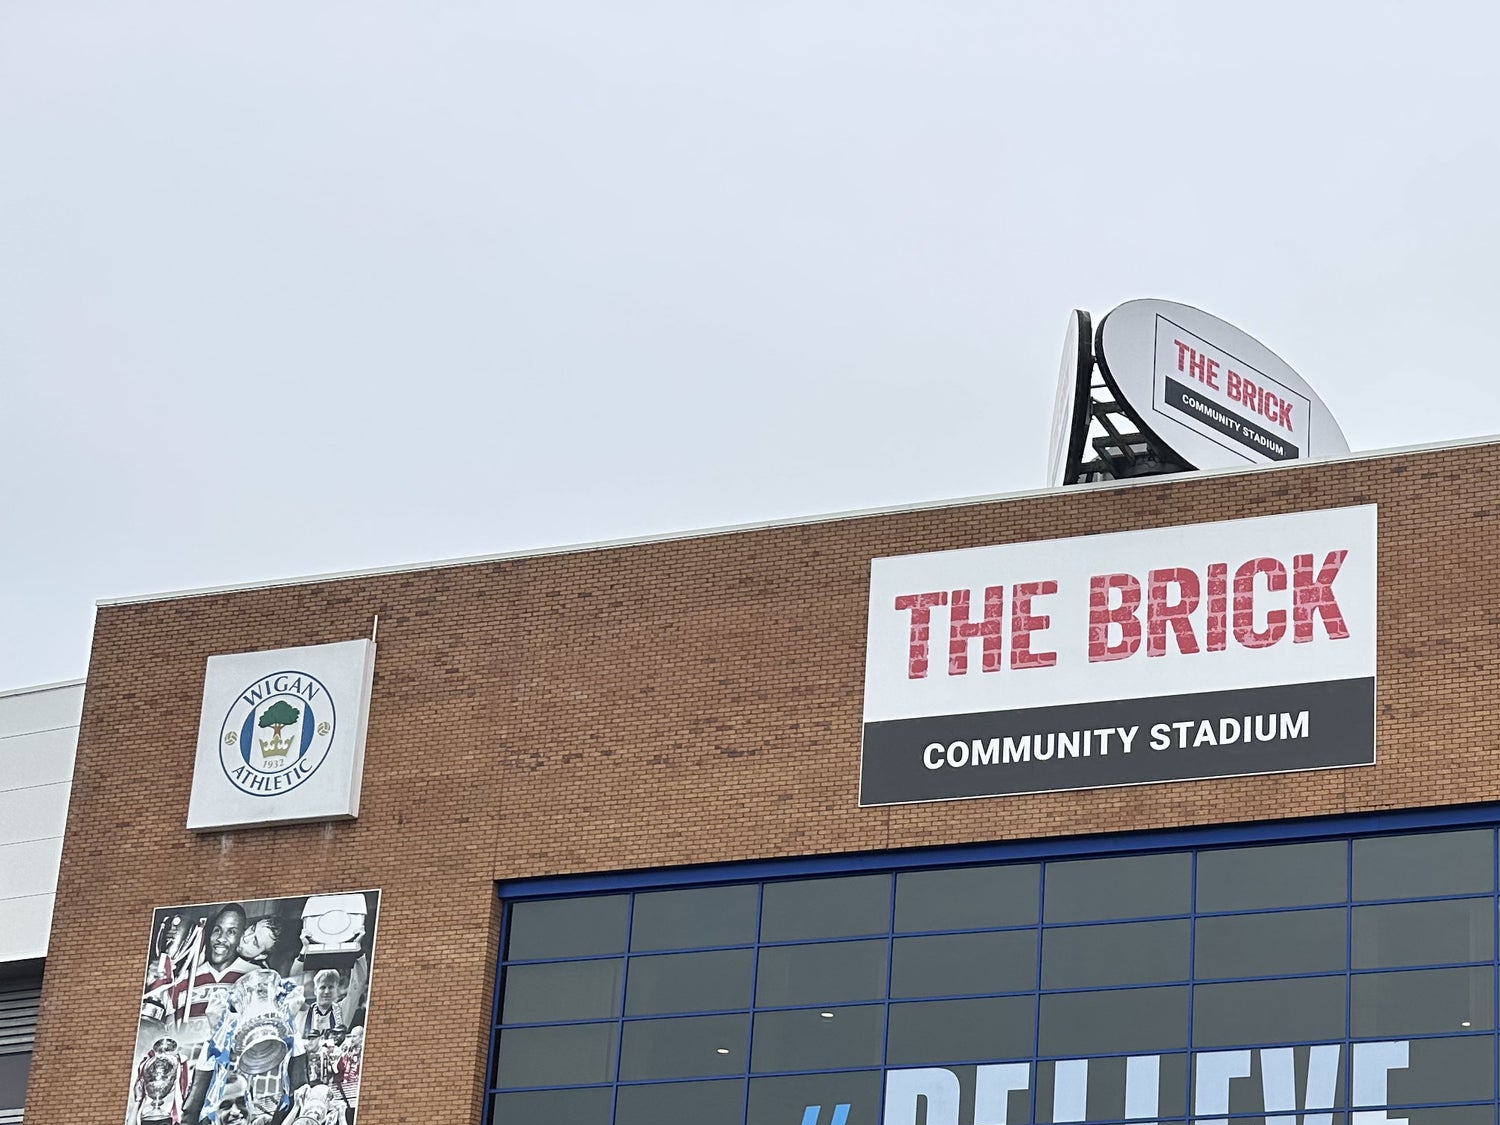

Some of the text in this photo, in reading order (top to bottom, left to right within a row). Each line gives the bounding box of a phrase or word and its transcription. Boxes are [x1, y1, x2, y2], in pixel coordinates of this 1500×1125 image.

[1174, 338, 1293, 432] THE BRICK
[1182, 394, 1284, 456] COMMUNITY STADIUM
[895, 549, 1351, 680] THE BRICK
[243, 675, 320, 706] WIGAN
[263, 759, 284, 769] 1932
[922, 710, 1310, 770] COMMUNITY STADIUM
[232, 758, 313, 791] ATHLETIC
